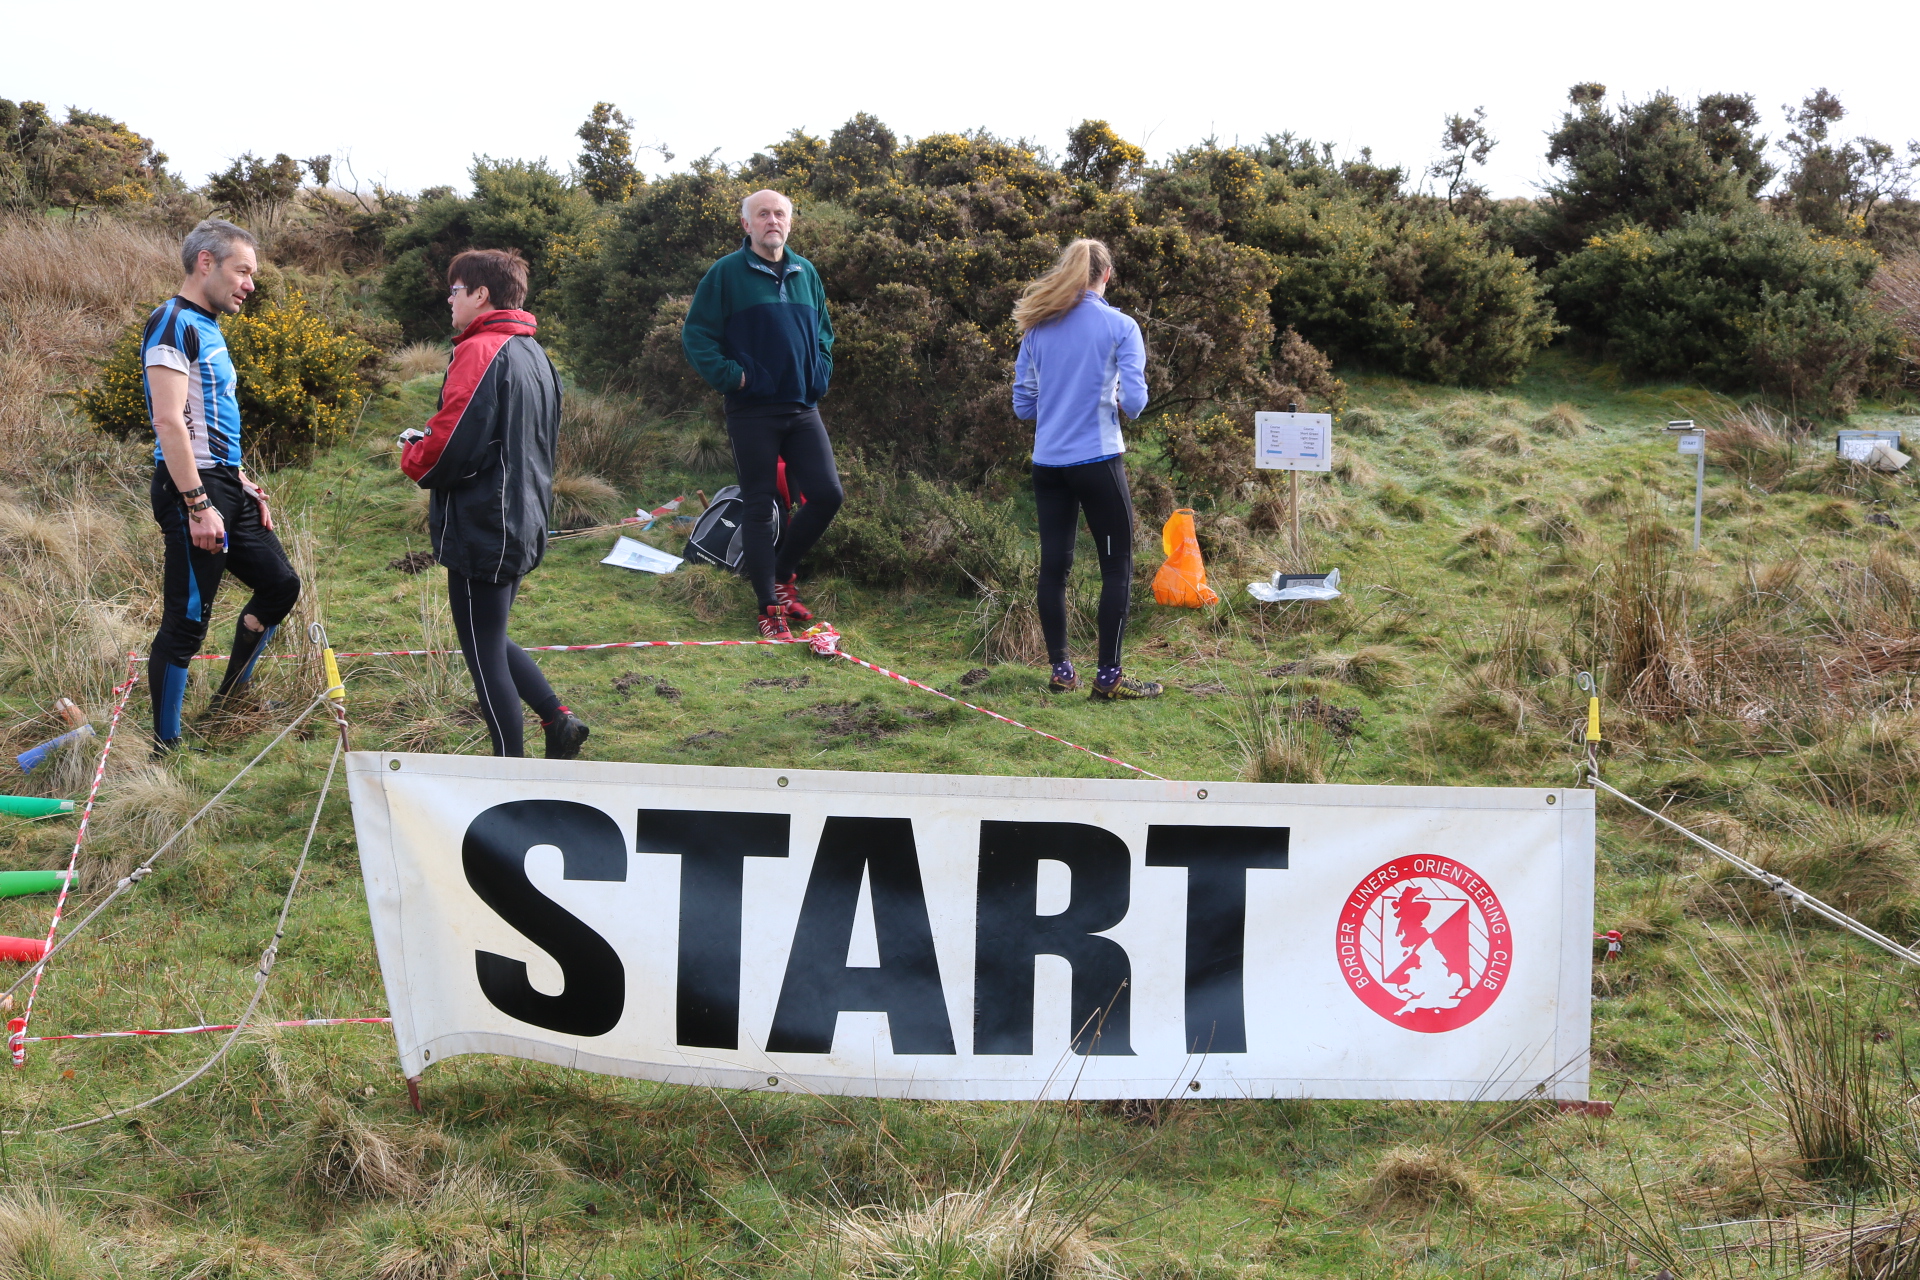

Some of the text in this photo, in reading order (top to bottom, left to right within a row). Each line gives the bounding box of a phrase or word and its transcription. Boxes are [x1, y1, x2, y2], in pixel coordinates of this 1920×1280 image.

[462, 799, 1290, 1056] START
[1340, 859, 1508, 991] BORDER LINERS ORIENTEERING CLUB
